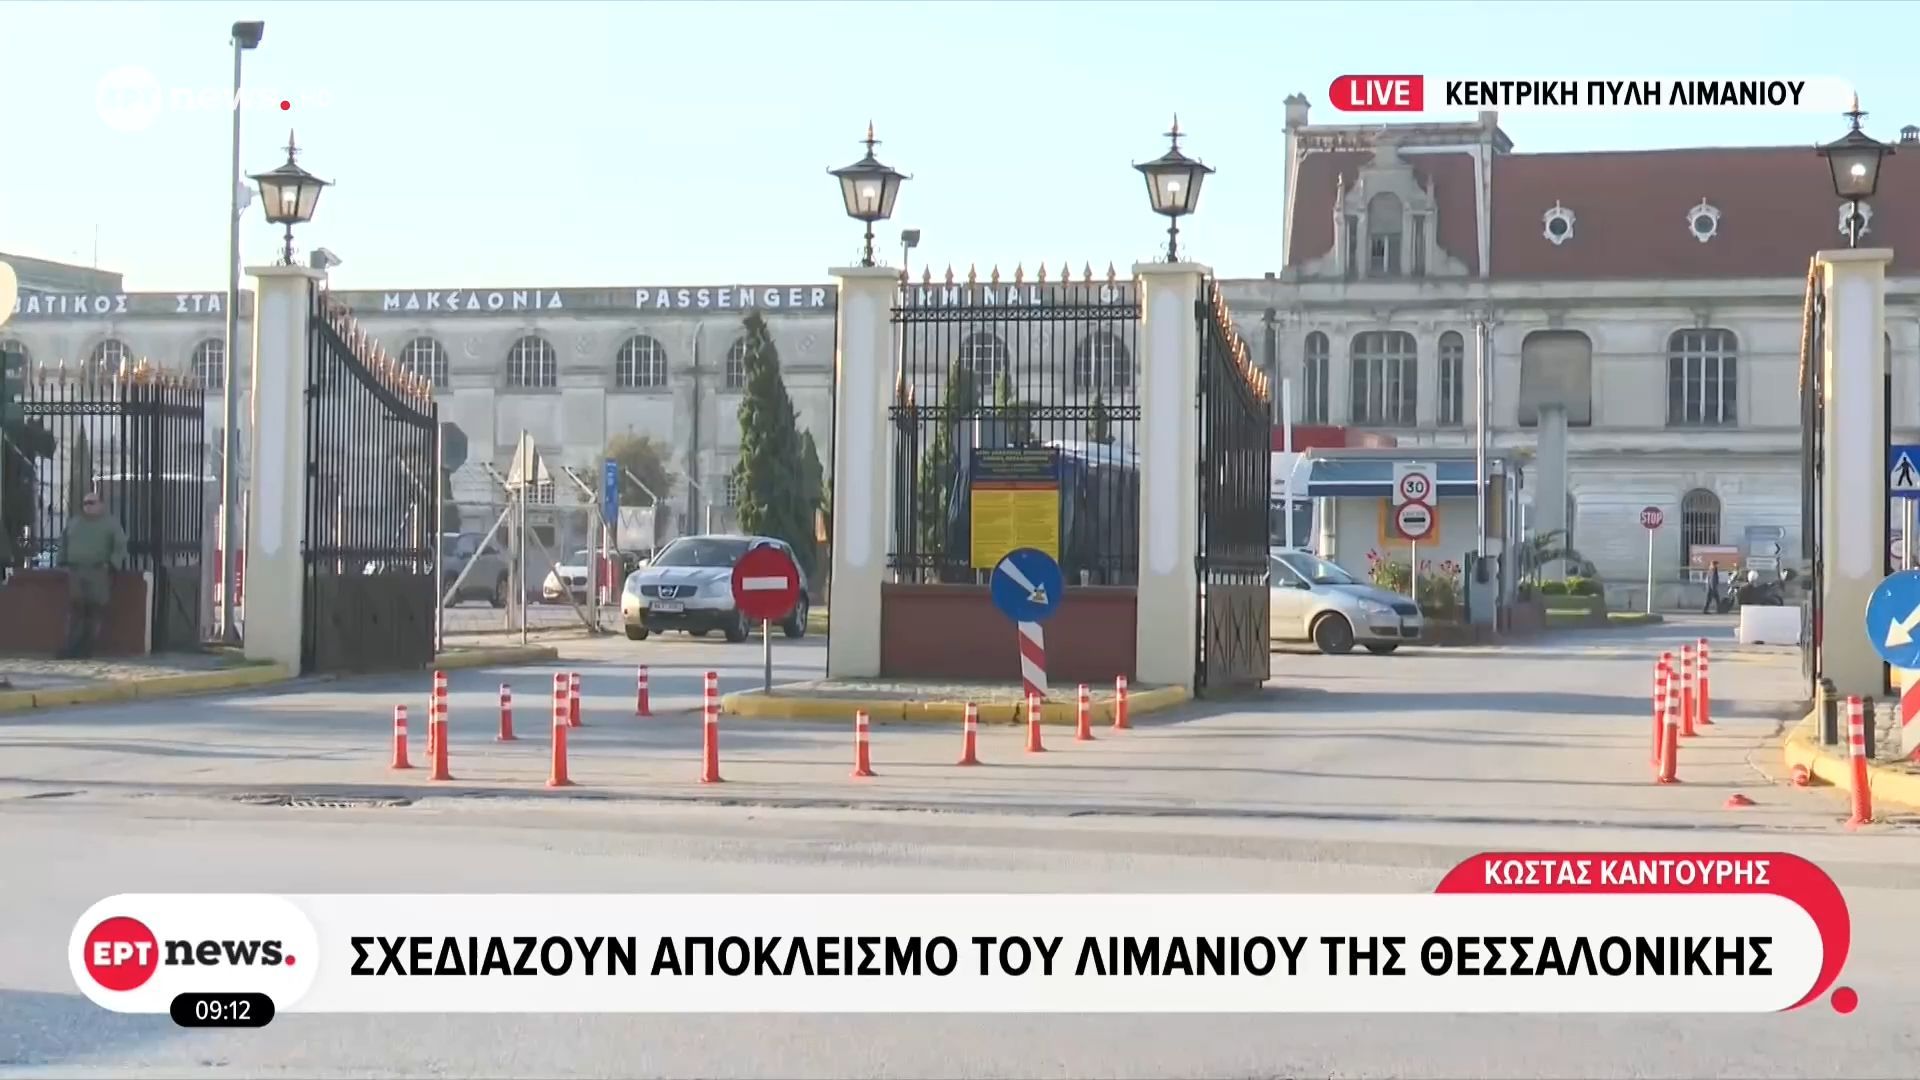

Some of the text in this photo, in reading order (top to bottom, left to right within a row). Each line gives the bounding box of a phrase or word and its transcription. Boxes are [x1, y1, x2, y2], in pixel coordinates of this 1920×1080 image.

[635, 287, 826, 309] PASSENGER
[1406, 480, 1424, 493] 30
[1640, 511, 1663, 525] STOP
